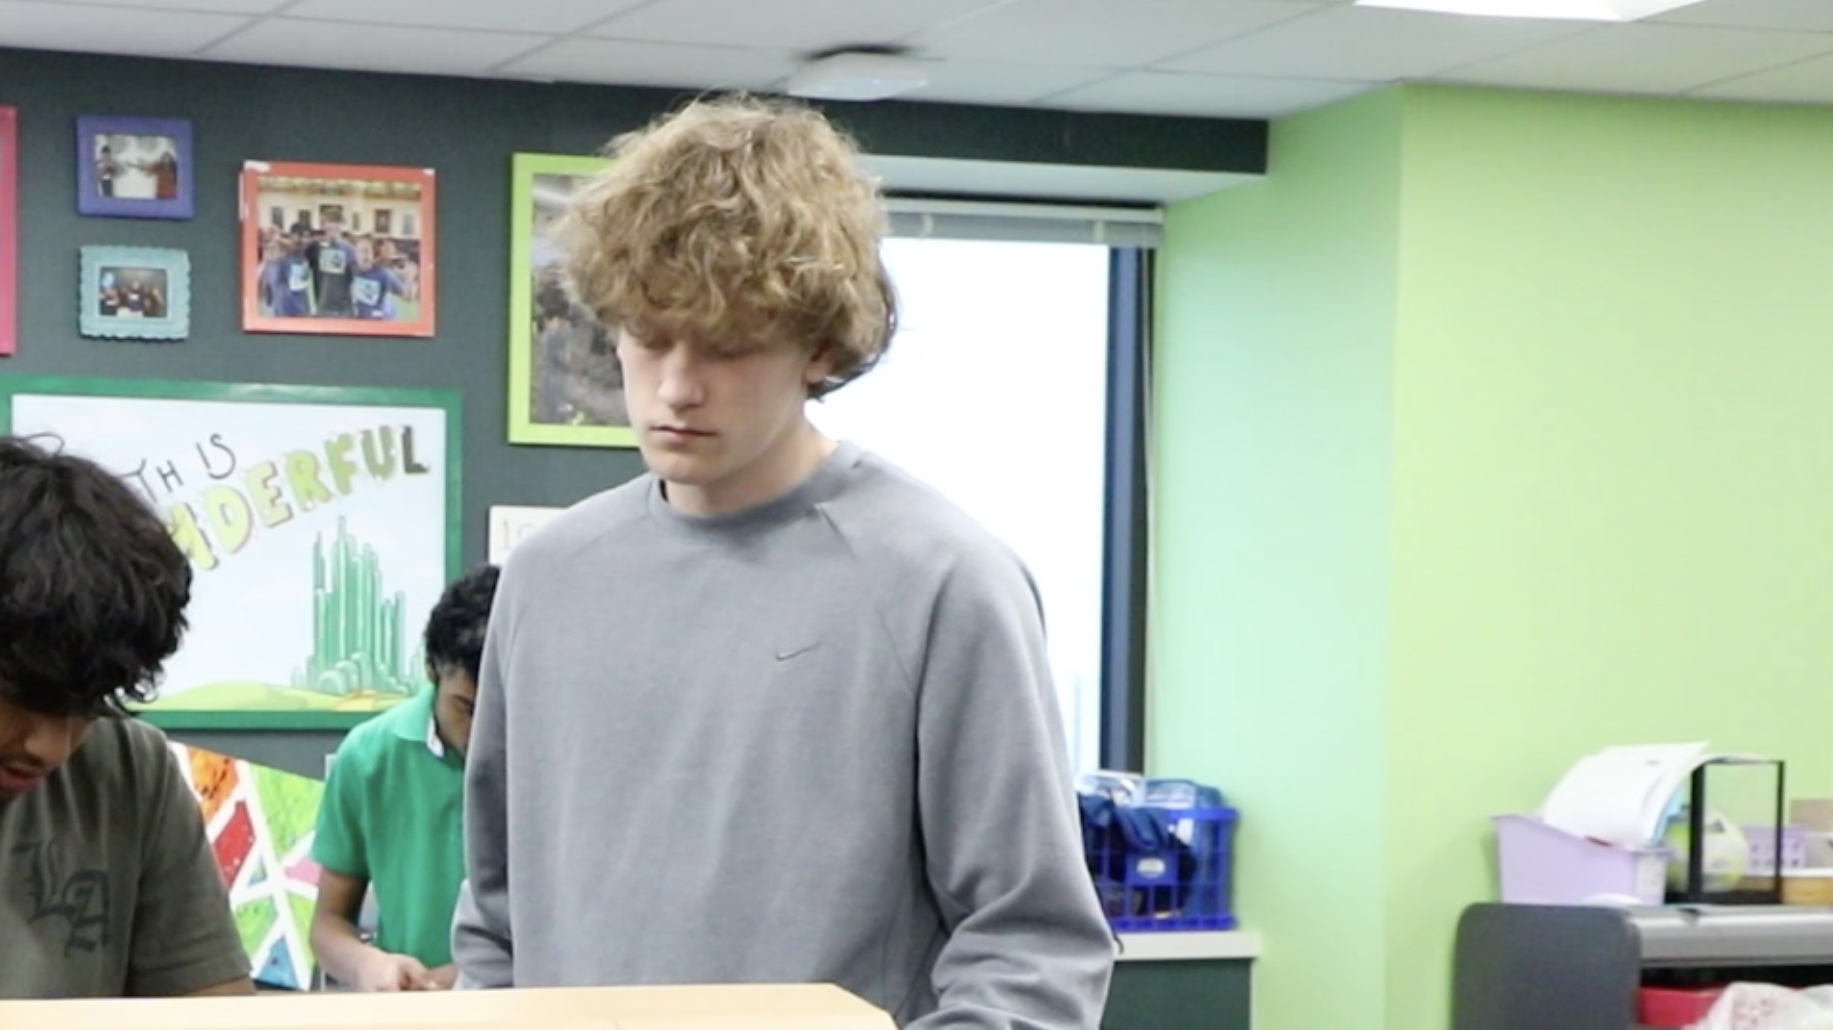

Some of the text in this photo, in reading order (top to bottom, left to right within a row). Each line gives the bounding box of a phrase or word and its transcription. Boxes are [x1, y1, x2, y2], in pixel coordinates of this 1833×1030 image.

[116, 432, 237, 504] TH IS
[167, 424, 430, 572] NDERFUL
